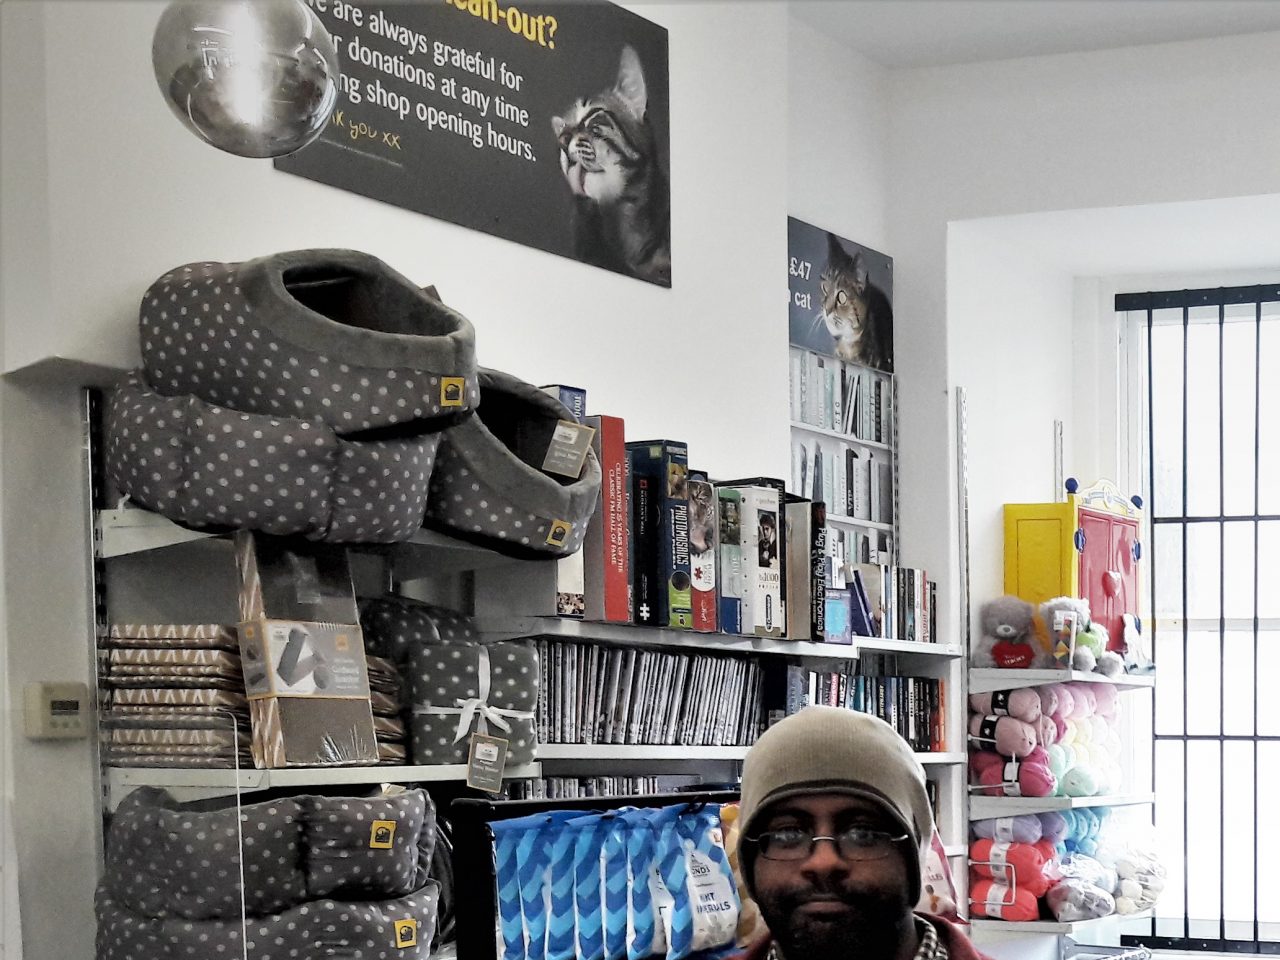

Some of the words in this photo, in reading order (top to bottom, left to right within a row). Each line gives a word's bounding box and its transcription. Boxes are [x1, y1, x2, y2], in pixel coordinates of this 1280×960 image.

[444, 0, 558, 50] ean-out?
[309, 0, 328, 13] e
[332, 0, 364, 28] are
[368, 10, 429, 55] always
[433, 41, 496, 82] grateful
[500, 61, 524, 92] for
[348, 36, 436, 91] donations
[441, 77, 457, 100] at
[461, 86, 491, 117] any
[494, 95, 529, 127] time
[339, 73, 362, 104] ng
[366, 80, 411, 120] shop
[415, 102, 484, 149] opening
[487, 121, 537, 162] hours.
[349, 119, 378, 140] you
[789, 256, 812, 281] £47
[794, 290, 812, 310] cat
[608, 469, 616, 499] CLASSIC
[609, 500, 616, 512] FM
[610, 533, 617, 543] OF
[675, 505, 689, 566] PHOTOMOSAICS
[815, 527, 828, 548] Plug
[617, 547, 624, 556] OF
[815, 557, 827, 578] Play
